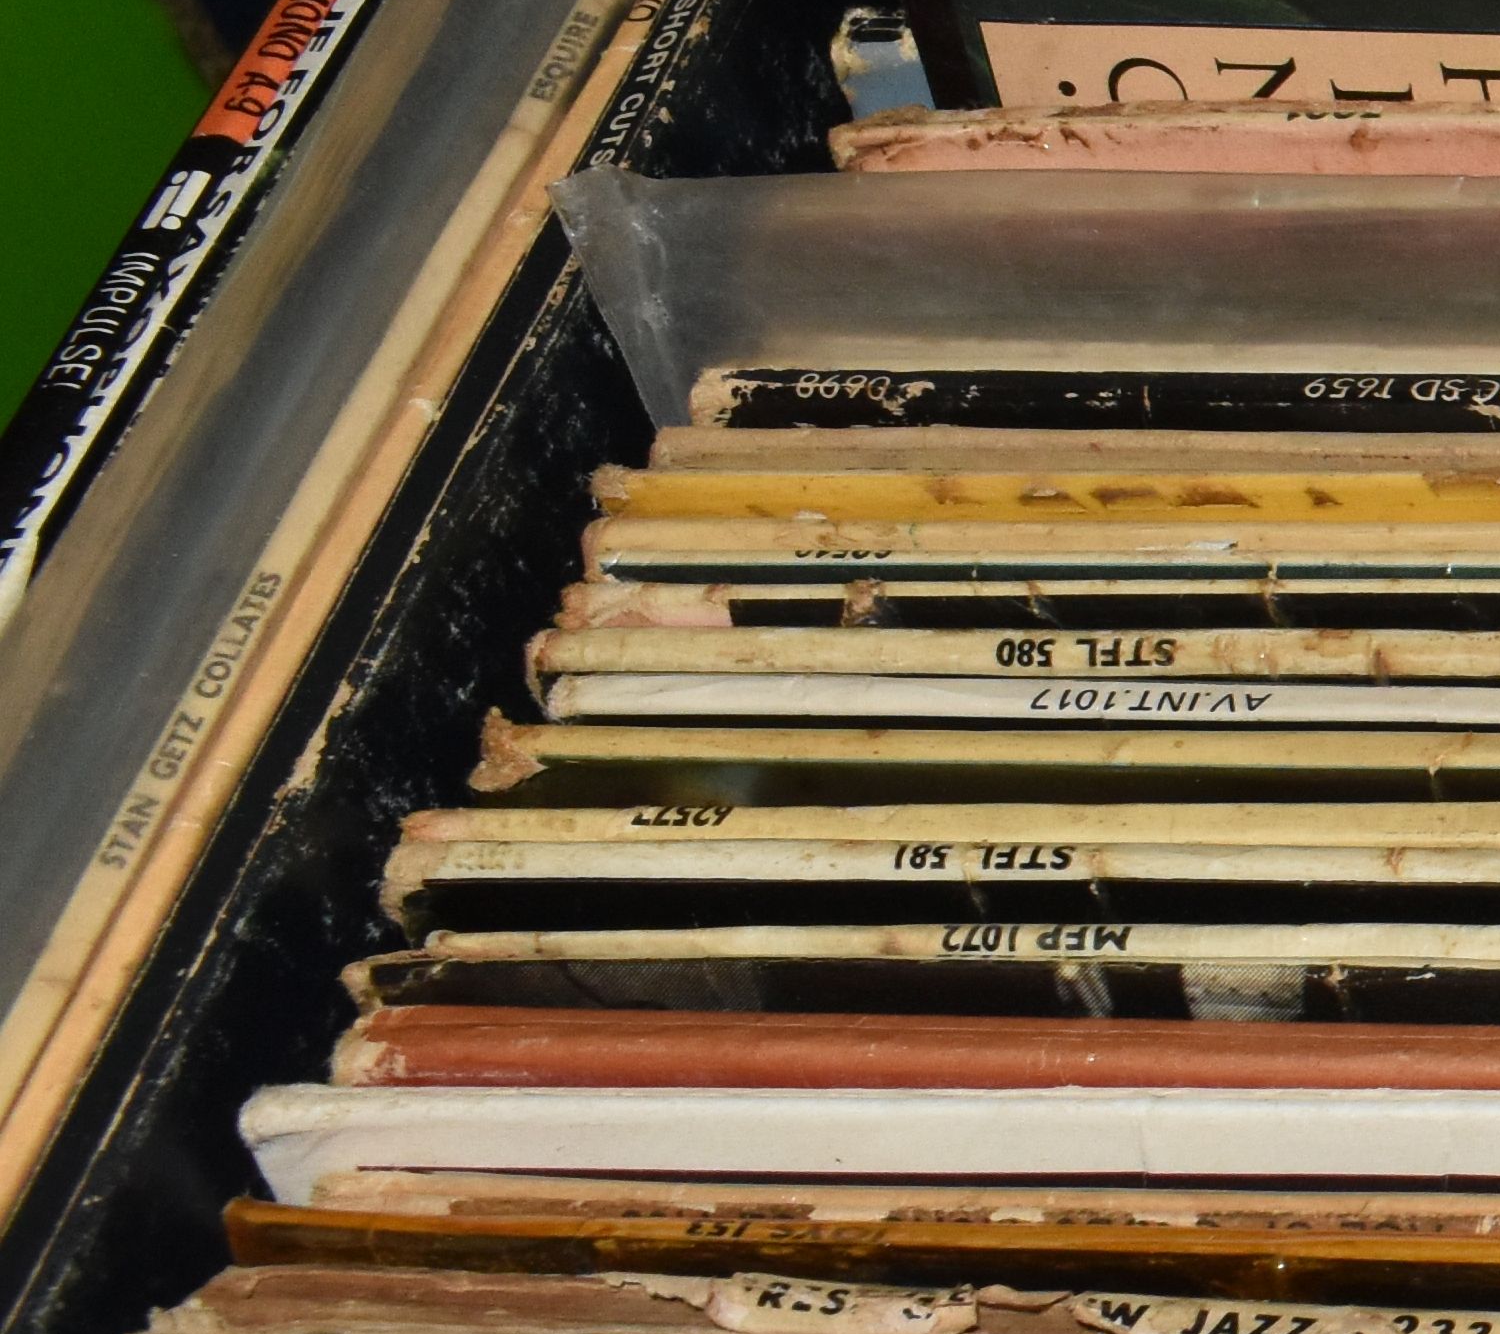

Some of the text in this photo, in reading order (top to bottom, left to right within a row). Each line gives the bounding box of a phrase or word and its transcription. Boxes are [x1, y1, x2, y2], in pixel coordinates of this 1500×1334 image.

[527, 8, 601, 106] ESQUIRE
[589, 89, 646, 167] CUTS
[995, 637, 1178, 668] STFL 580
[101, 571, 283, 870] STAN GETZ COLLATES
[893, 844, 951, 871] 581
[941, 924, 1130, 955] MFP 1072
